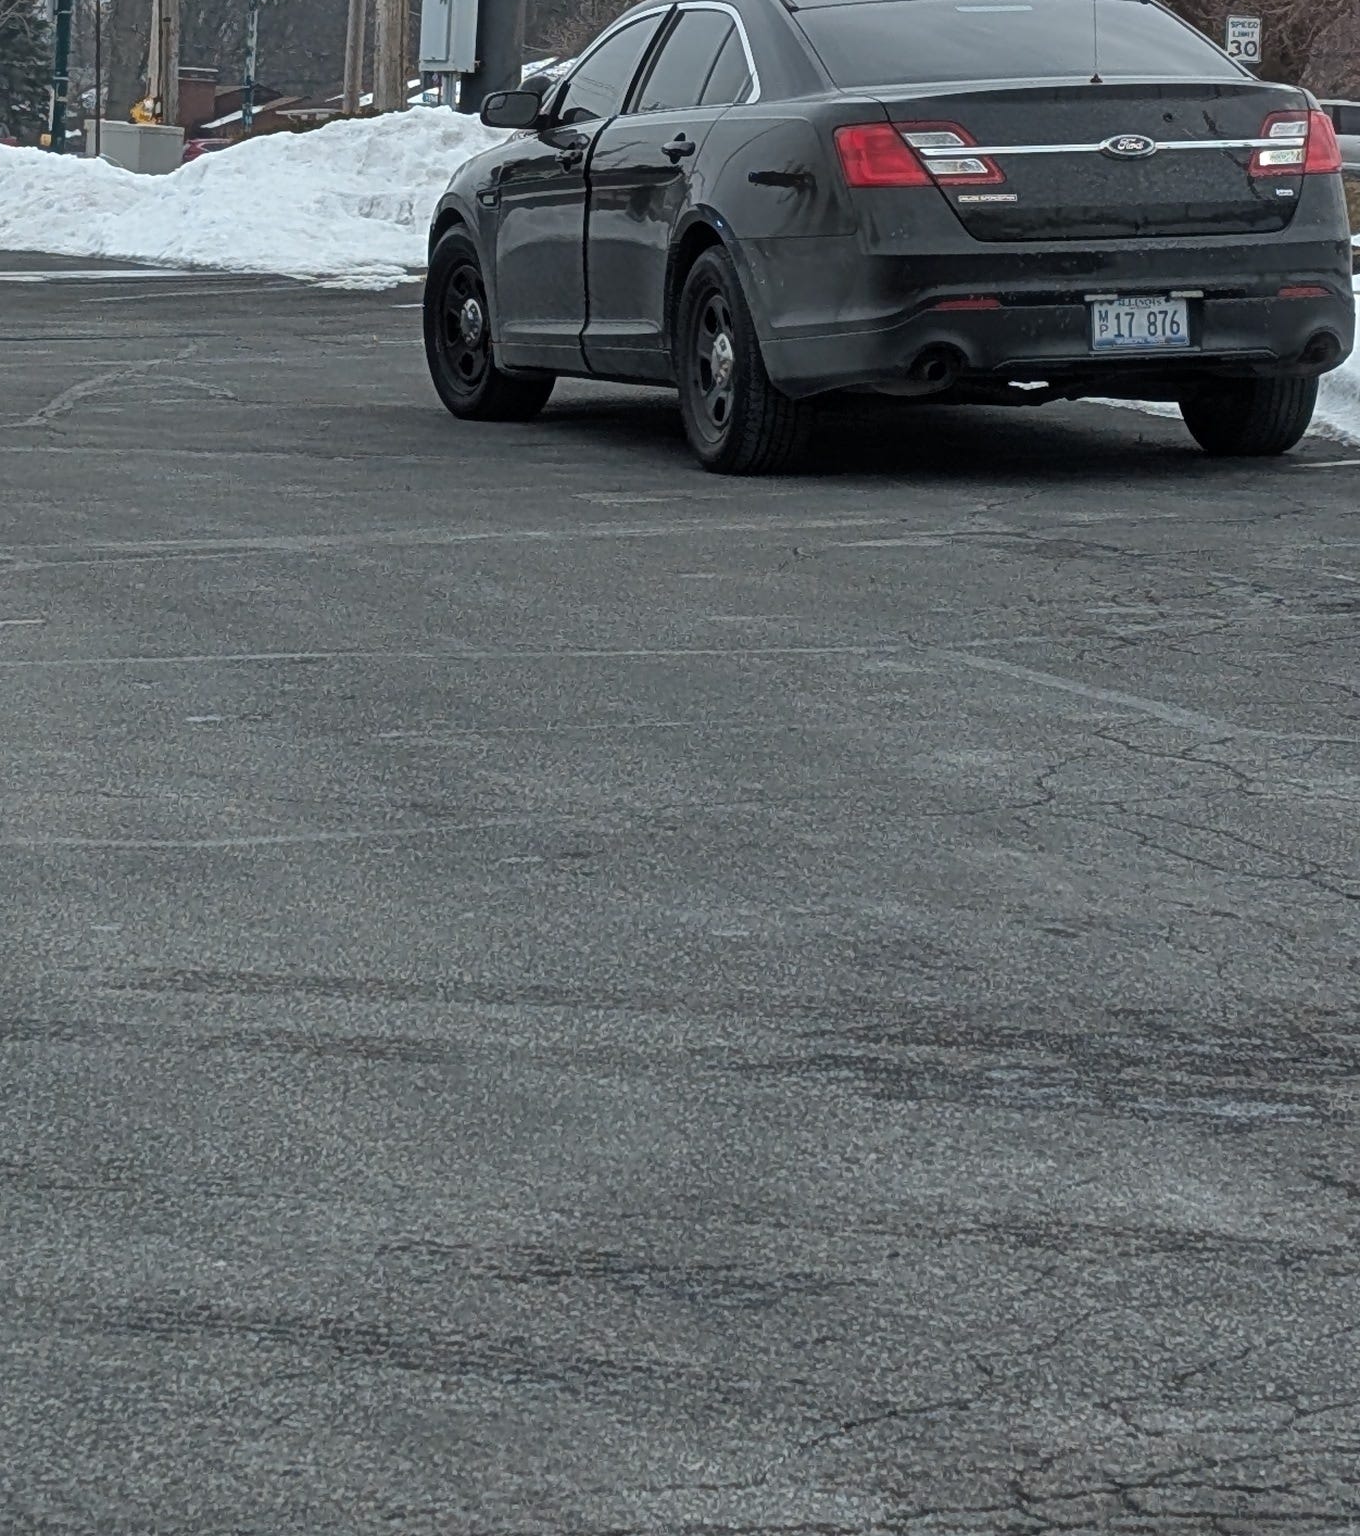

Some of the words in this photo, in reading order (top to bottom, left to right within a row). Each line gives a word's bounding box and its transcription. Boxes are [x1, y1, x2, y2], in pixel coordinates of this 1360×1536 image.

[1228, 40, 1258, 58] 30
[1114, 311, 1136, 338] 17
[1146, 309, 1181, 336] 876
